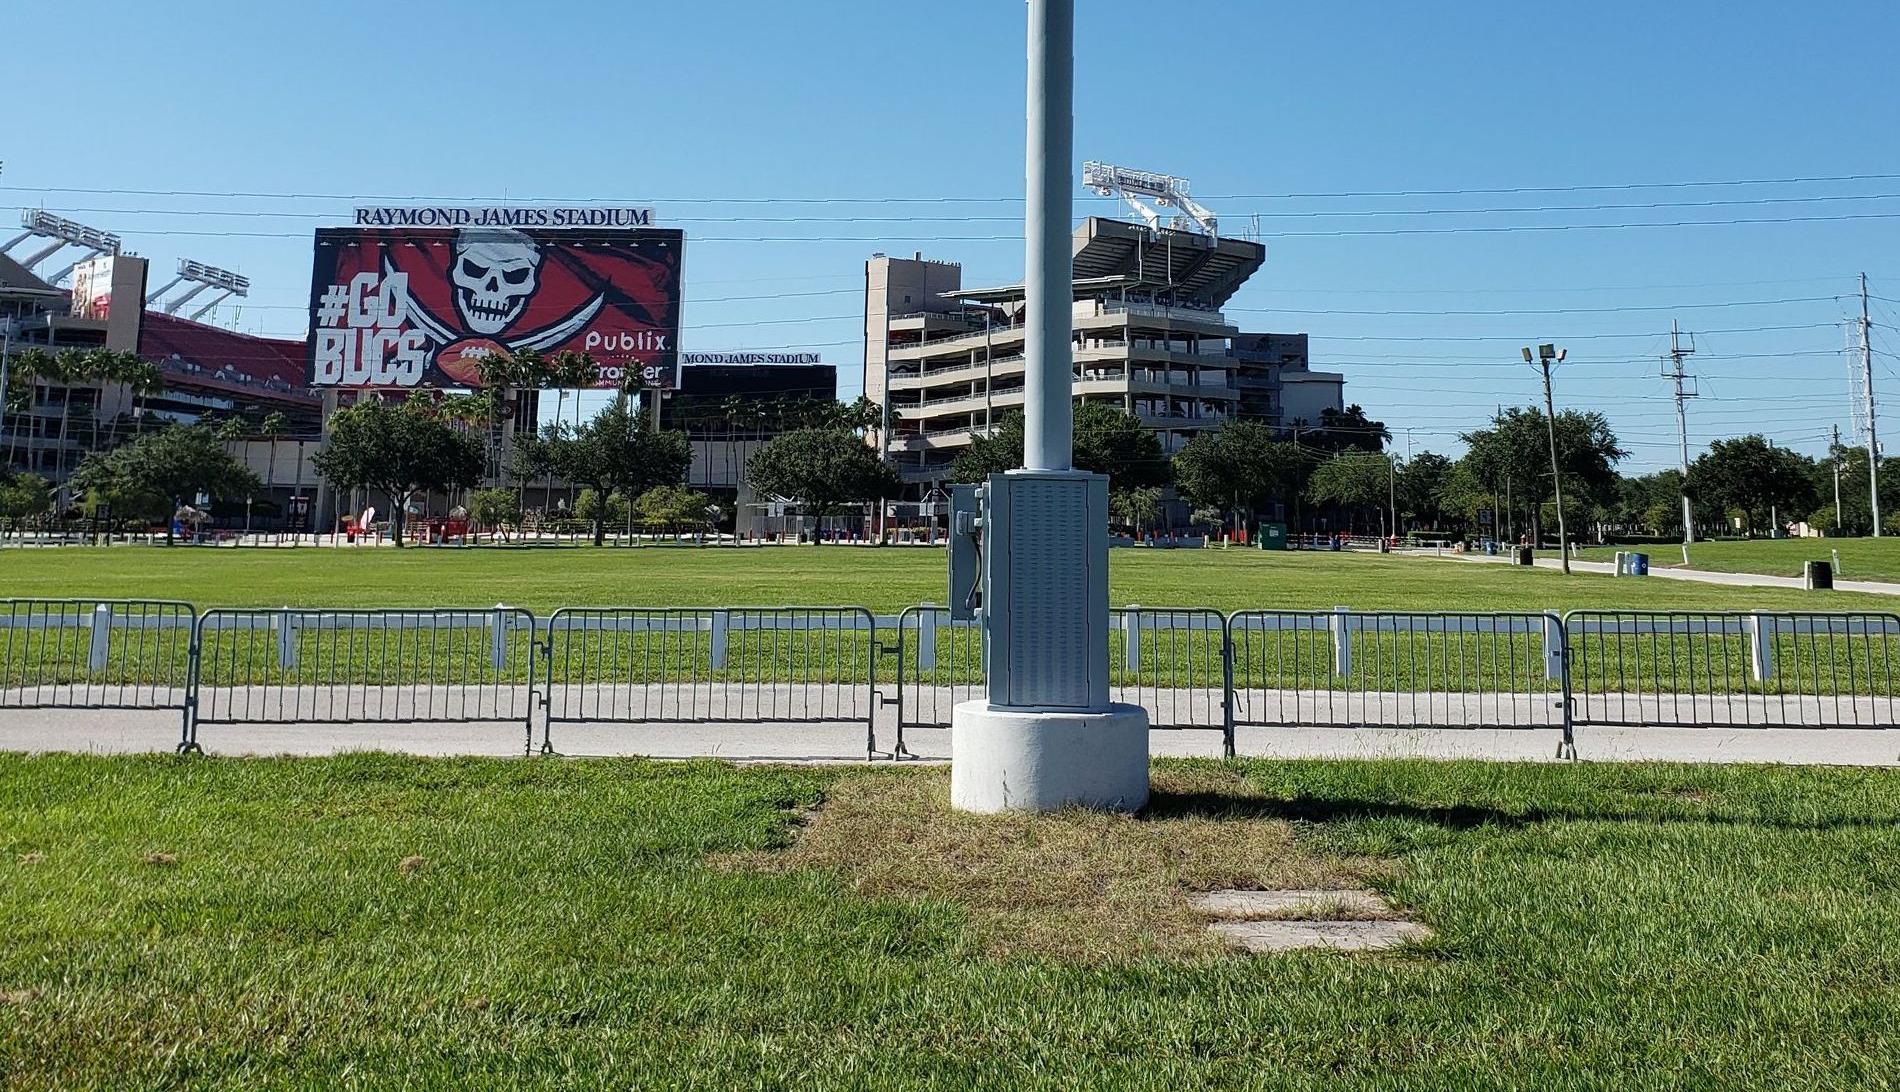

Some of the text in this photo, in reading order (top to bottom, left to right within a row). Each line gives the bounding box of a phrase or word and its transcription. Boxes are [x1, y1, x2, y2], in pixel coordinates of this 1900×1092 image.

[355, 208, 649, 226] RAYMOND JAMES STADIUM
[317, 272, 409, 328] #GO
[585, 331, 667, 351] Publix
[315, 328, 426, 386] BUCS
[725, 353, 765, 364] JAMES
[767, 353, 819, 364] STADIUM
[589, 364, 663, 379] Froer
